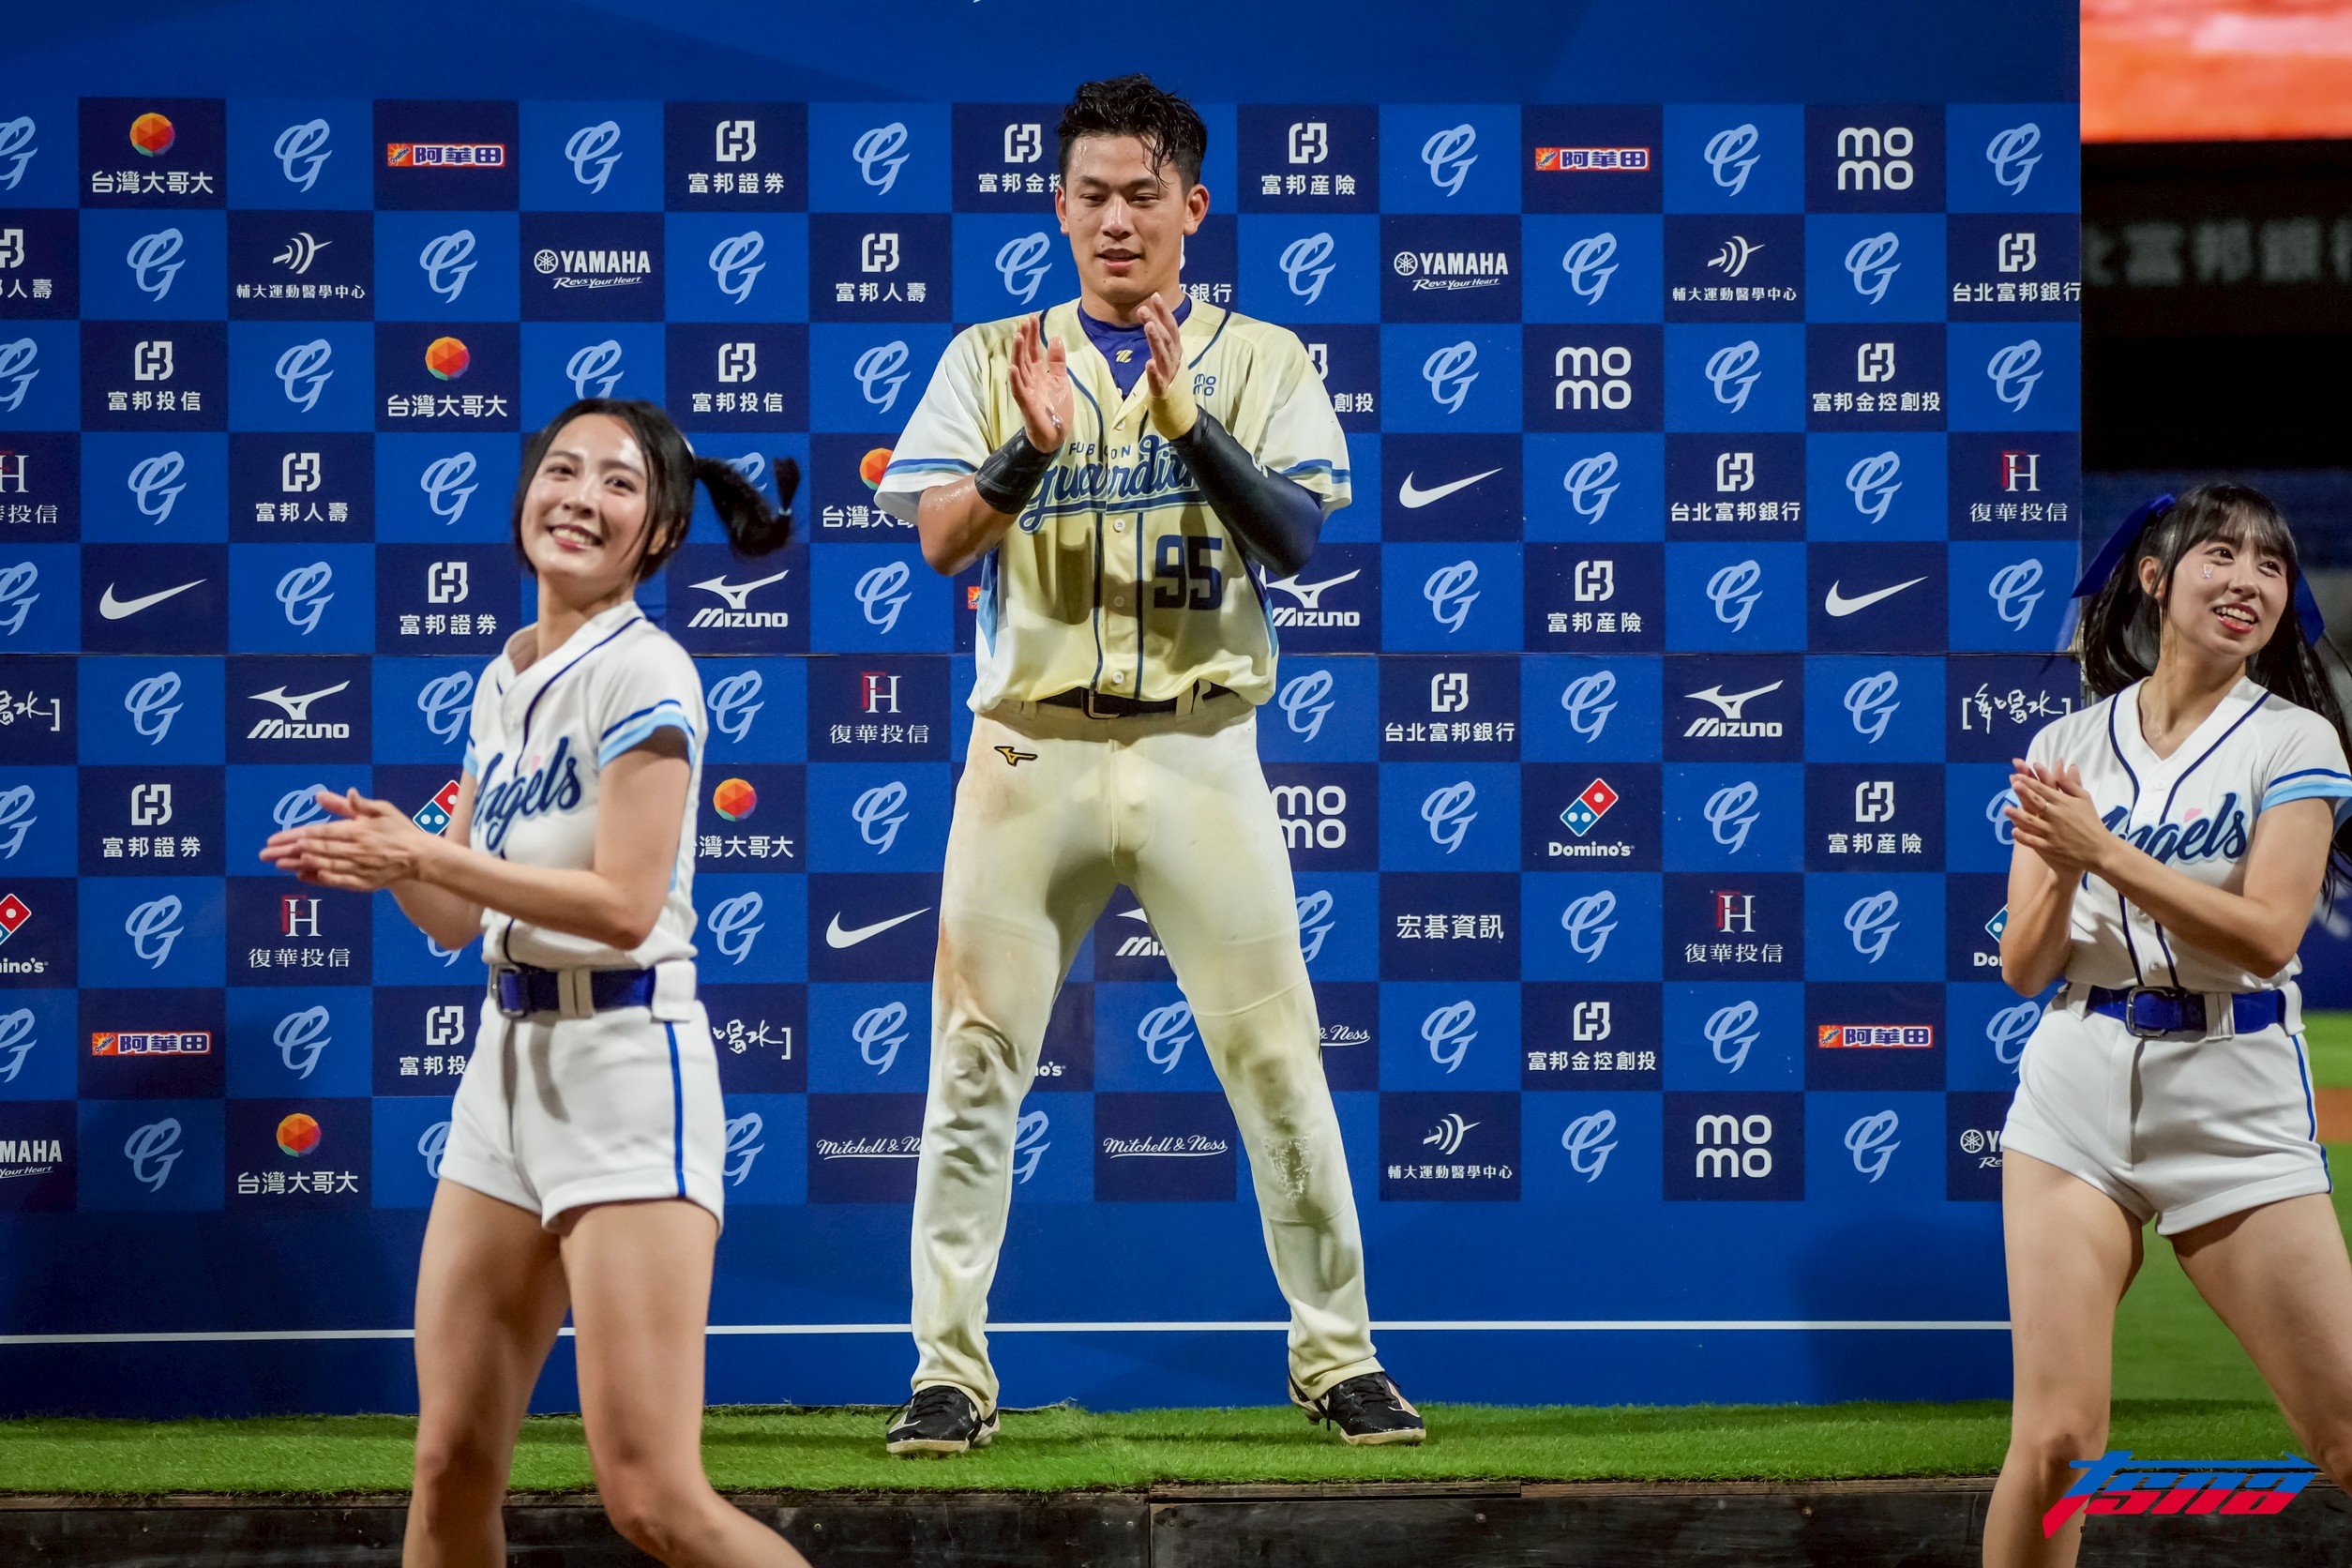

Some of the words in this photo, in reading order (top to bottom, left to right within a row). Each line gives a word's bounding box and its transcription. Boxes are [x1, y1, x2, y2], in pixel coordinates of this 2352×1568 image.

[413, 145, 504, 166] 阿華田
[1560, 149, 1648, 170] 阿華田
[91, 170, 214, 195] 台灣大哥大
[687, 172, 785, 194] 富邦證券
[560, 249, 652, 274] YAMAHA
[1419, 251, 1509, 276] YAMAHA
[0, 279, 53, 299] 人壽
[236, 283, 366, 299] 輔大運動醫學中心
[589, 278, 613, 289] Your
[613, 276, 641, 285] Heart
[835, 281, 927, 303] 富邦人壽
[1447, 279, 1471, 291] Your
[1471, 278, 1500, 287] Heart
[1952, 281, 2081, 303] 台北富邦銀行
[1672, 286, 1797, 302] 輔大運動醫學中心
[107, 390, 201, 412] 富邦投信
[387, 394, 508, 418] 台灣大哥大
[691, 392, 783, 413] 富邦投信
[1333, 392, 1374, 414] 創投
[1812, 391, 1941, 413] 富邦金控創投
[1019, 434, 1202, 535] Guardi
[255, 502, 349, 523] 富邦人壽
[1670, 501, 1802, 522] 台北富邦銀行
[1969, 502, 2069, 523] 復華投信
[1153, 535, 1222, 611] 95
[399, 613, 497, 636] 富邦證券
[829, 723, 930, 745] 復華投信
[1384, 721, 1515, 743] 台北富邦銀行
[102, 836, 202, 858] 富邦證券
[695, 835, 794, 859] 灣大哥大
[1548, 840, 1632, 858] Domino's
[1296, 889, 1335, 964] G?
[1396, 913, 1505, 940] 宏碁資訊
[248, 947, 351, 969] 復華投信
[1684, 942, 1784, 963] 復華投信
[0, 957, 46, 974] ino's
[117, 1033, 209, 1054] 阿華田
[1329, 1024, 1371, 1043] Ness
[1843, 1026, 1931, 1047] 阿華田
[399, 1055, 467, 1077] 富邦投
[1528, 1050, 1656, 1071] 富邦金控創投
[0, 1139, 64, 1164] MAHA
[816, 1137, 887, 1156] Mitchell
[1103, 1136, 1173, 1154] Mitchell
[1187, 1135, 1229, 1153] Ness
[24, 1166, 53, 1174] Heart
[1387, 1164, 1513, 1180] 輔大運動醫學中心
[237, 1170, 359, 1195] 台灣大哥大
